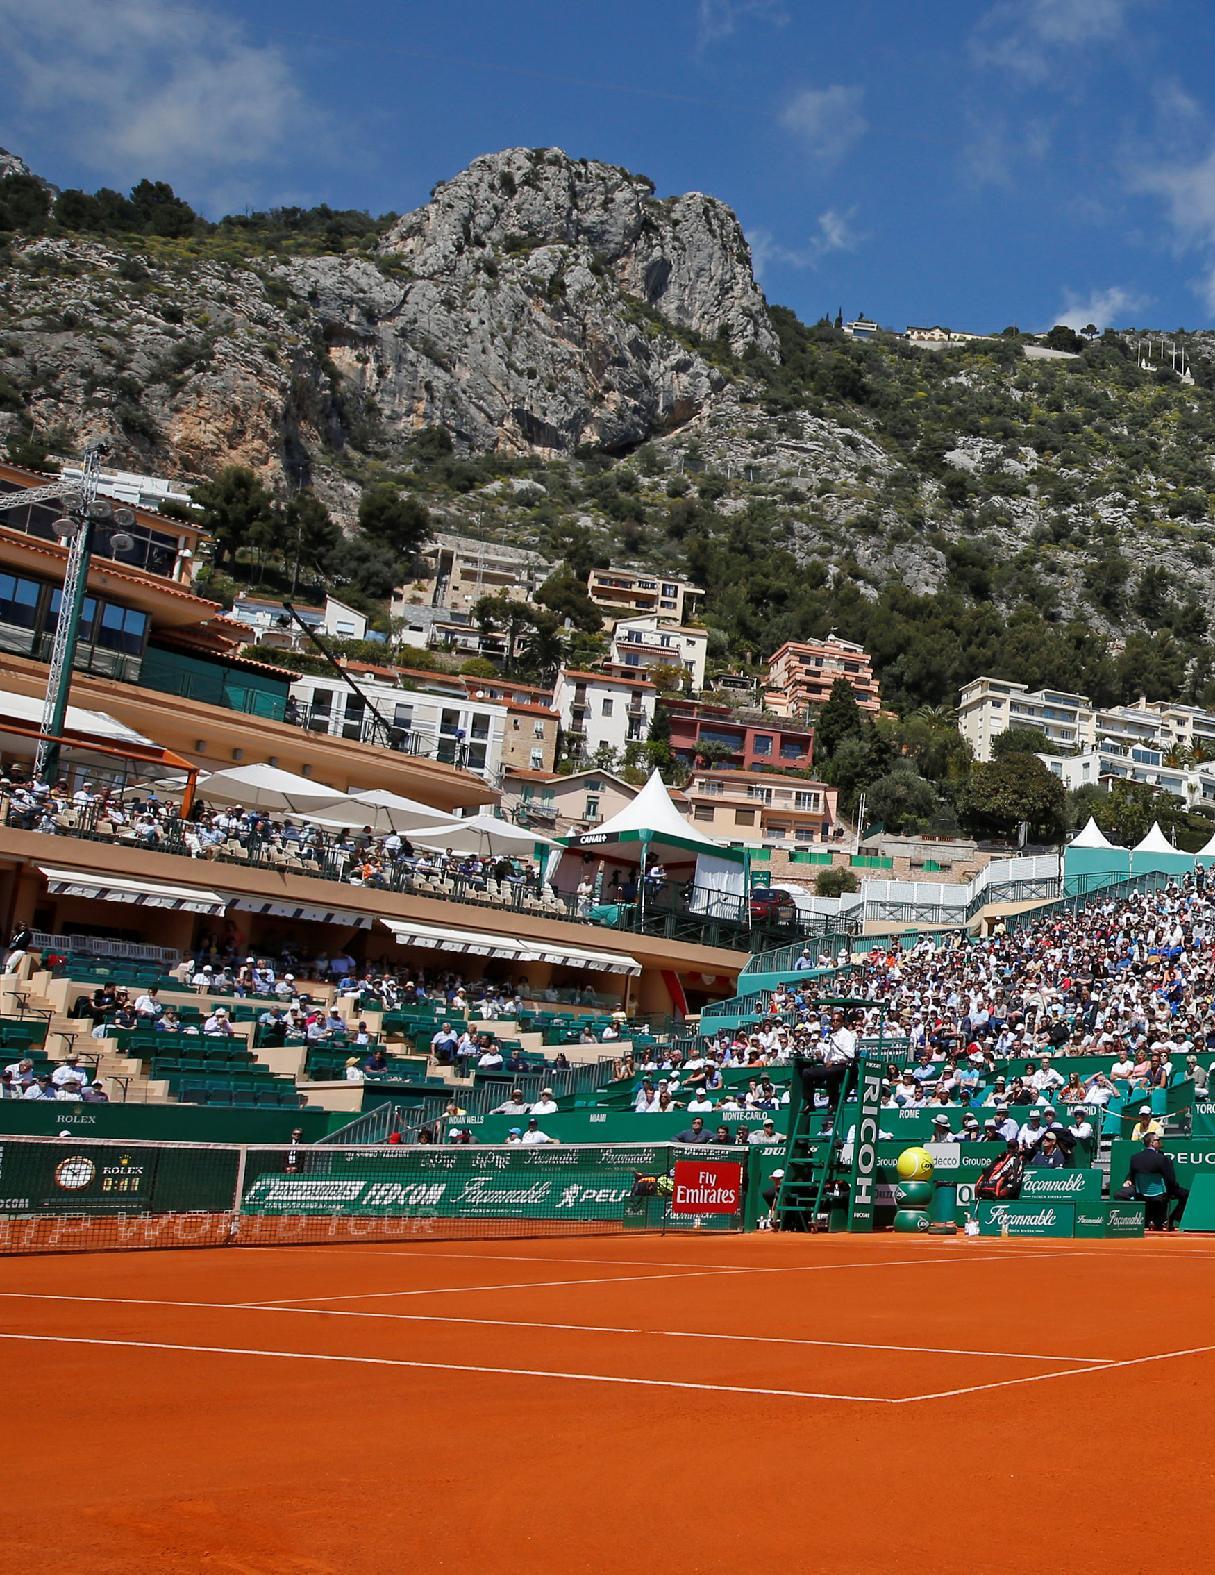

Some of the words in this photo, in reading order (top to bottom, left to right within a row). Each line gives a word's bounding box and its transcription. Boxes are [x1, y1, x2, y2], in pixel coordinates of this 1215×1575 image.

[722, 1111, 768, 1121] MONTE-CARLO
[899, 1109, 920, 1119] ROME
[1066, 1106, 1097, 1117] MID
[56, 1115, 96, 1124] ROLEX
[467, 1115, 484, 1124] WELLS
[856, 1075, 881, 1204] RICOH
[932, 1155, 957, 1166] decco
[698, 1171, 717, 1187] Fly
[676, 1184, 736, 1205] Emirates
